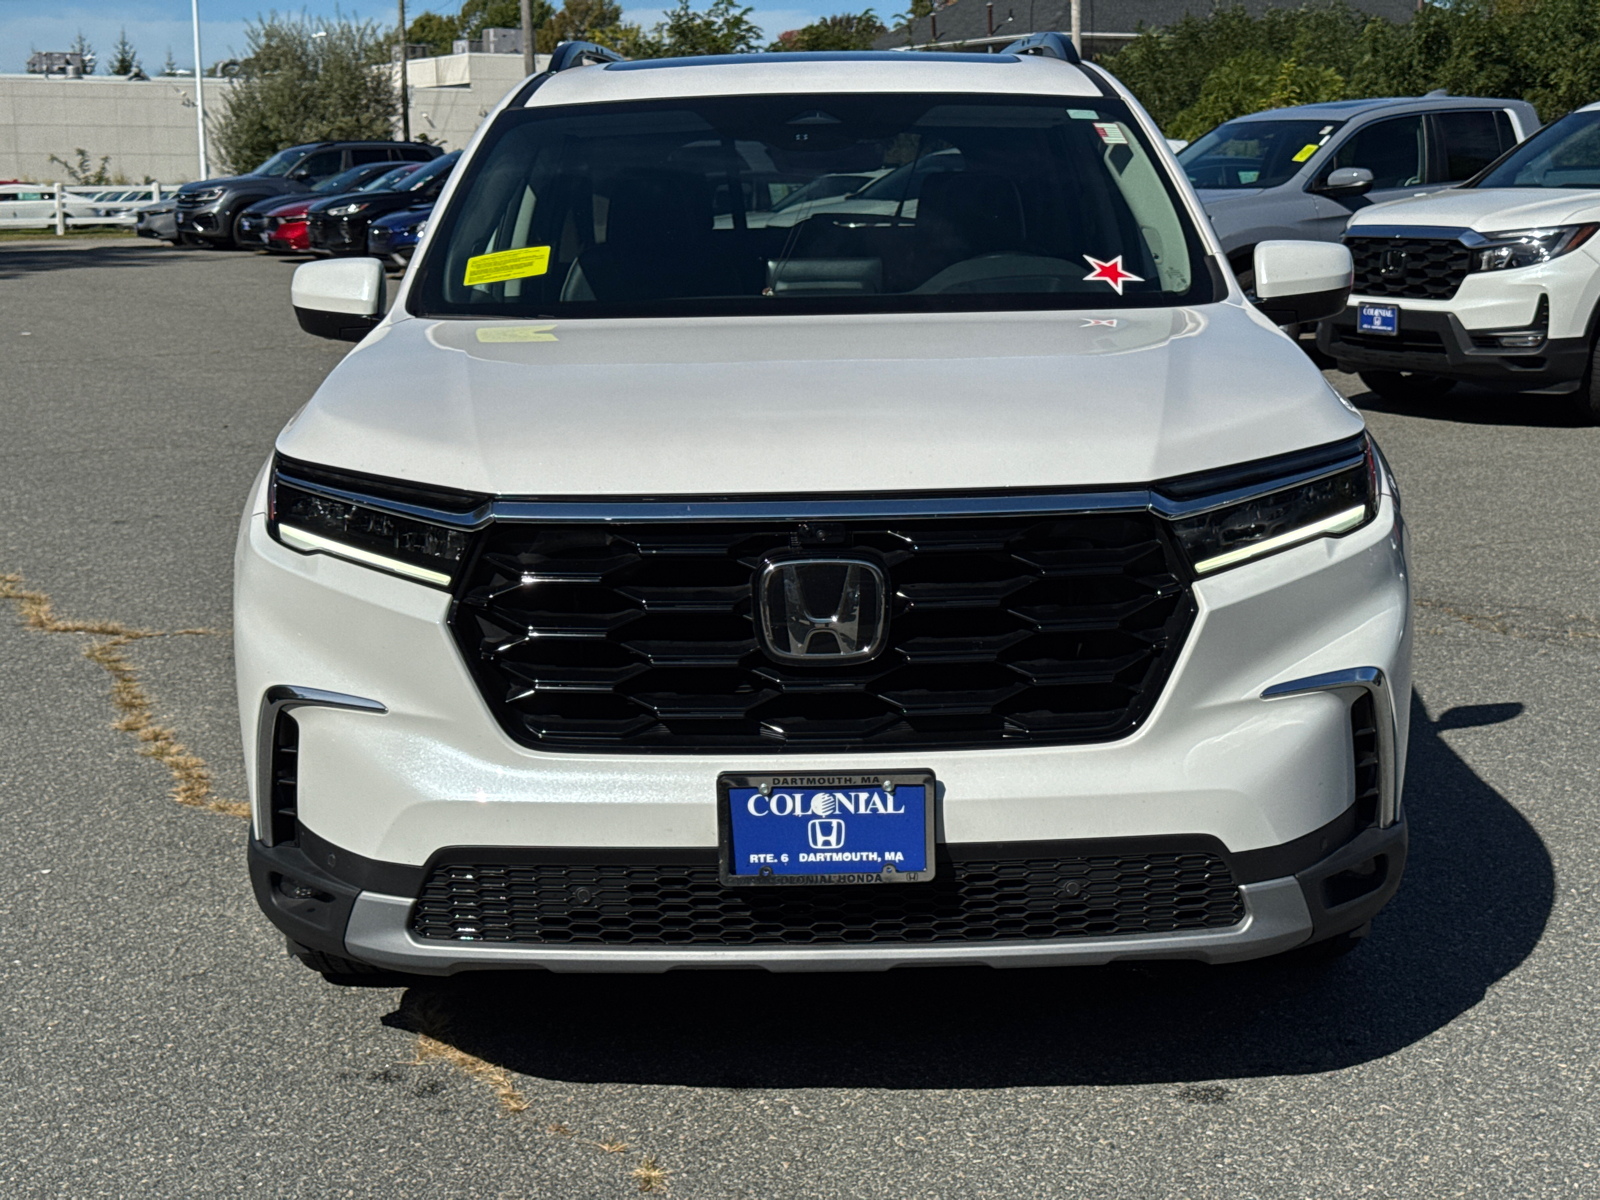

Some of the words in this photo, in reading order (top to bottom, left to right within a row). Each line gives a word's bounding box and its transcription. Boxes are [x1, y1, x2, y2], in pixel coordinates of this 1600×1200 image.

[772, 777, 857, 786] DARTMOUTH,
[860, 776, 880, 784] MA
[747, 791, 905, 817] COLONIAL
[749, 853, 778, 863] RTE.
[780, 853, 789, 863] 6
[798, 851, 882, 863] DARTMOUTH,
[884, 851, 904, 863] MA
[776, 874, 833, 885] COLONIAL
[838, 873, 883, 884] HONDA
